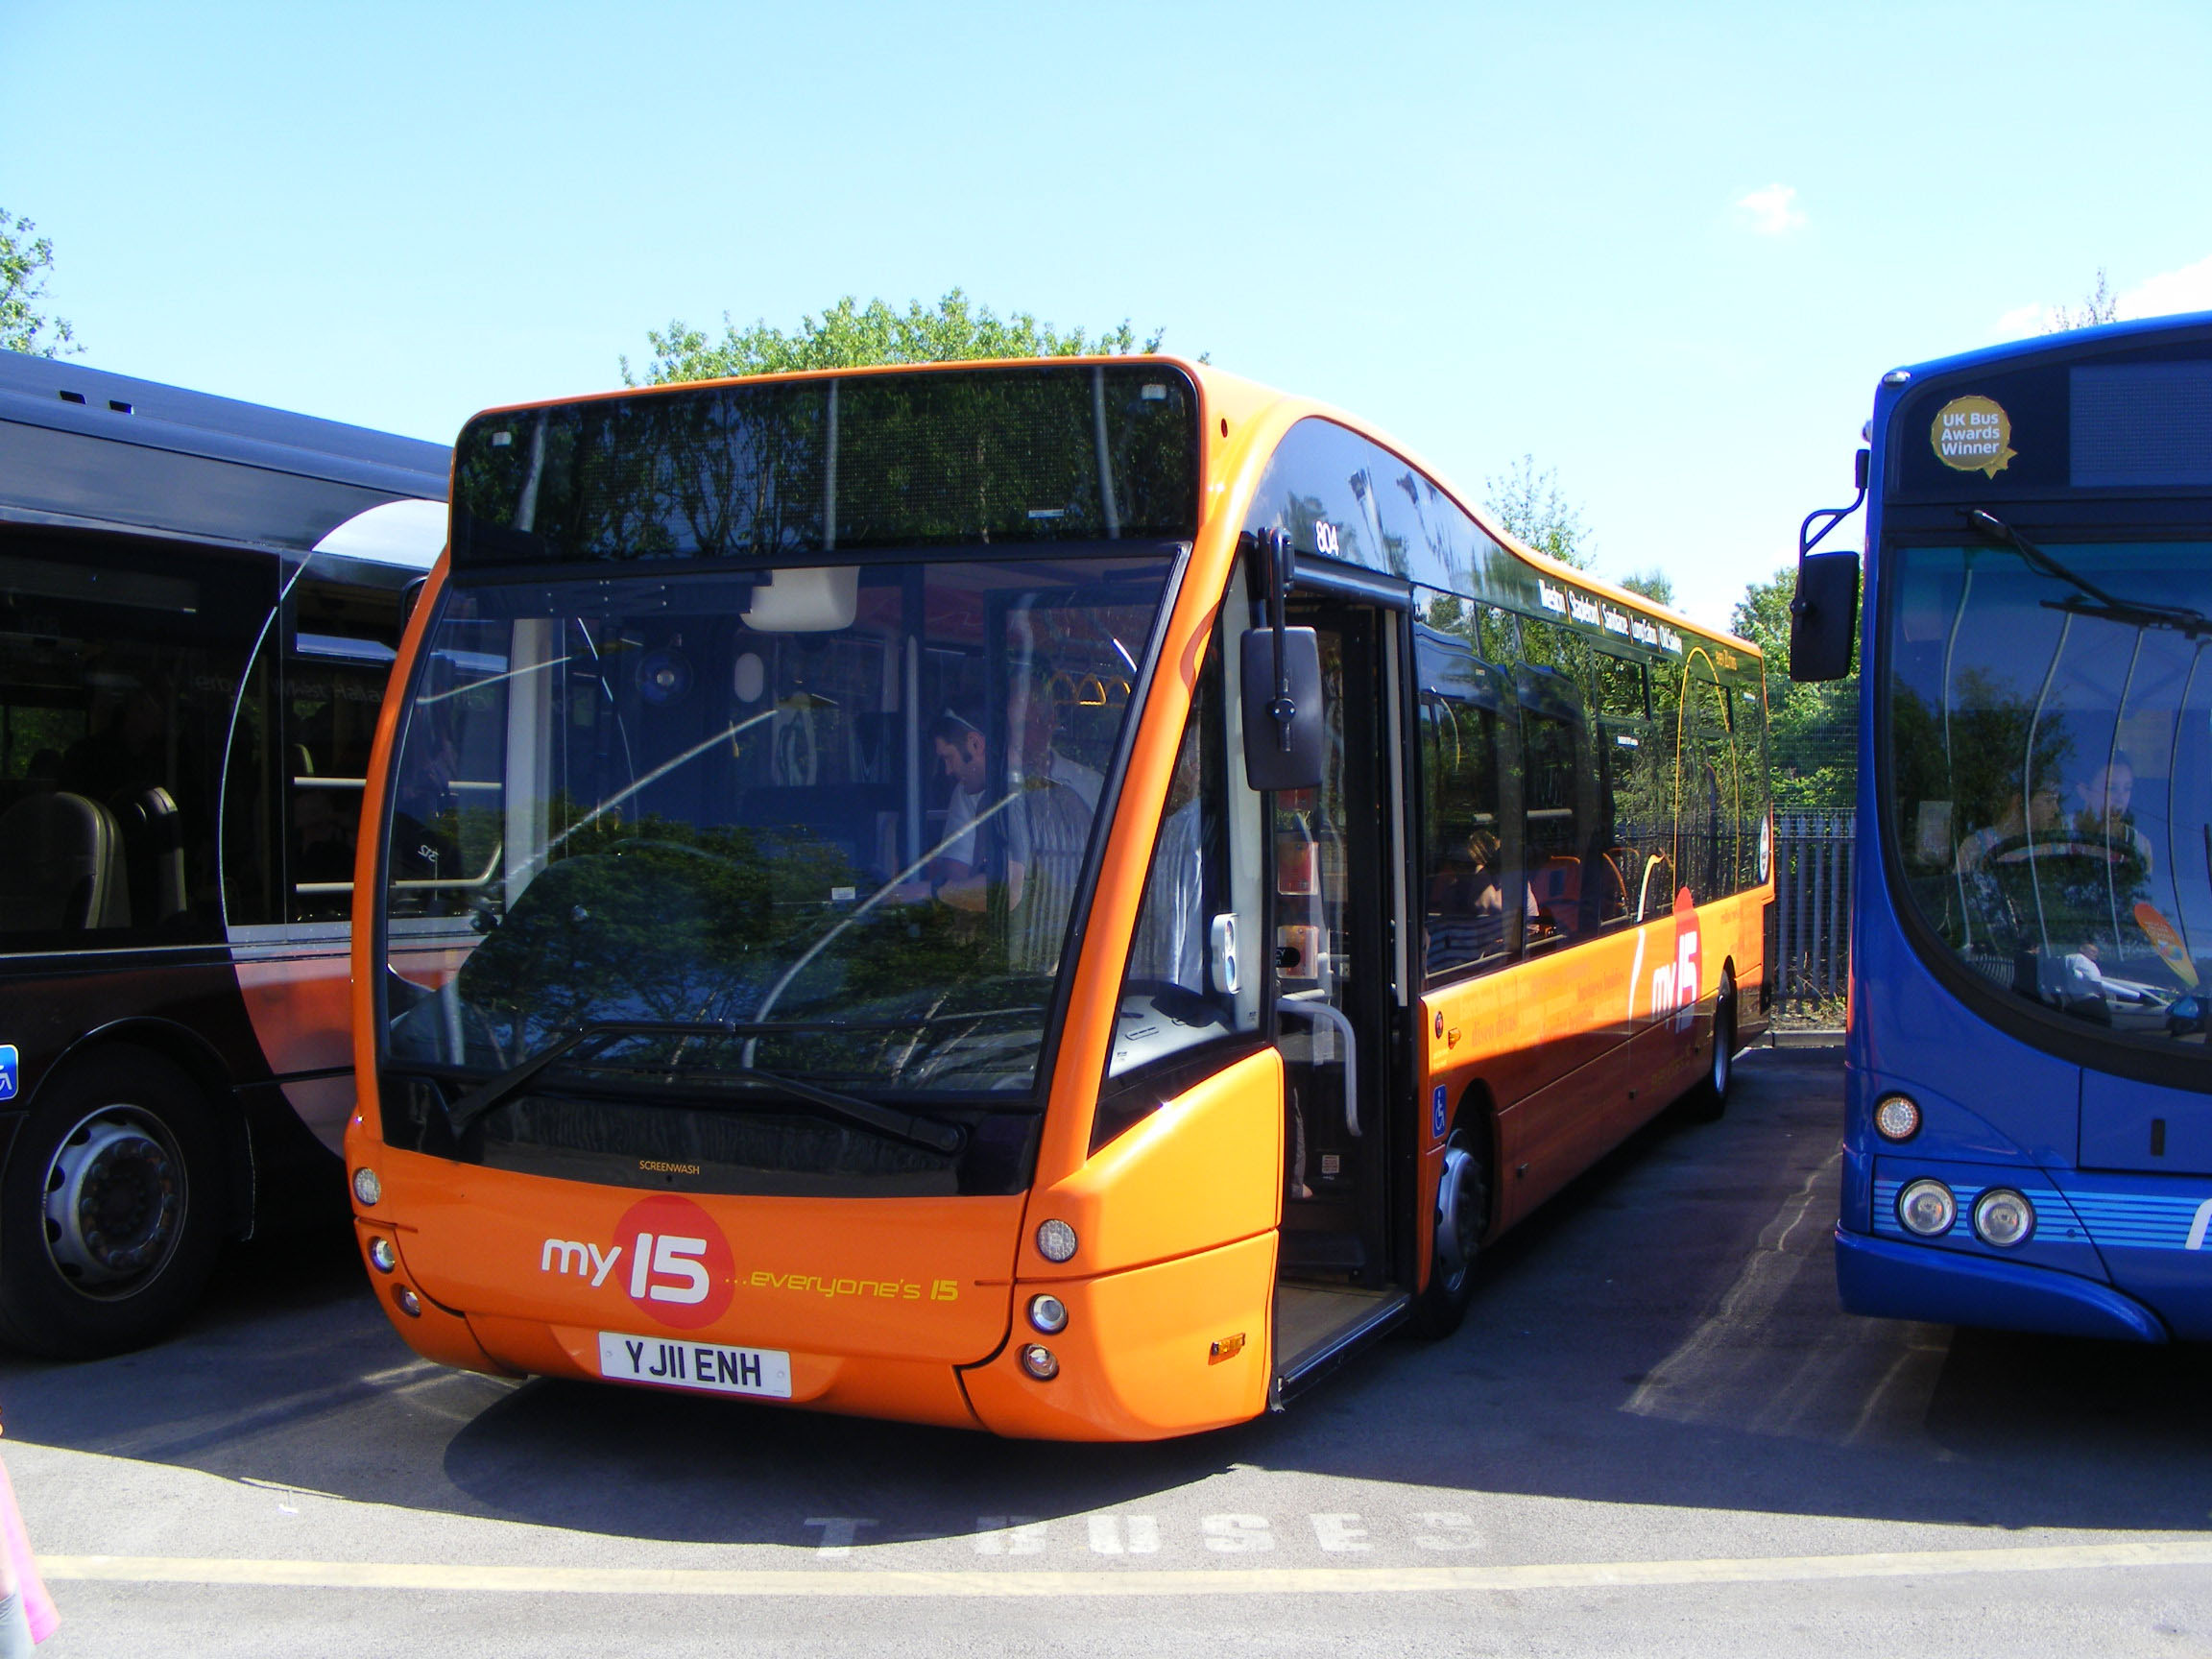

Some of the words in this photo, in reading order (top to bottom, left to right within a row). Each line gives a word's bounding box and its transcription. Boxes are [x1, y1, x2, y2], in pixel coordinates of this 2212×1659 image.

[1942, 413, 1966, 427] UK
[1970, 412, 2000, 425] Bus
[1941, 426, 2001, 442] Awards
[1941, 442, 2000, 456] Winner
[1315, 519, 1339, 557] 804
[638, 1159, 701, 1175] SCREENWASH
[541, 1238, 622, 1287] my
[629, 1232, 711, 1305] 15
[929, 1279, 959, 1302] 15
[694, 1348, 761, 1388] ENH
